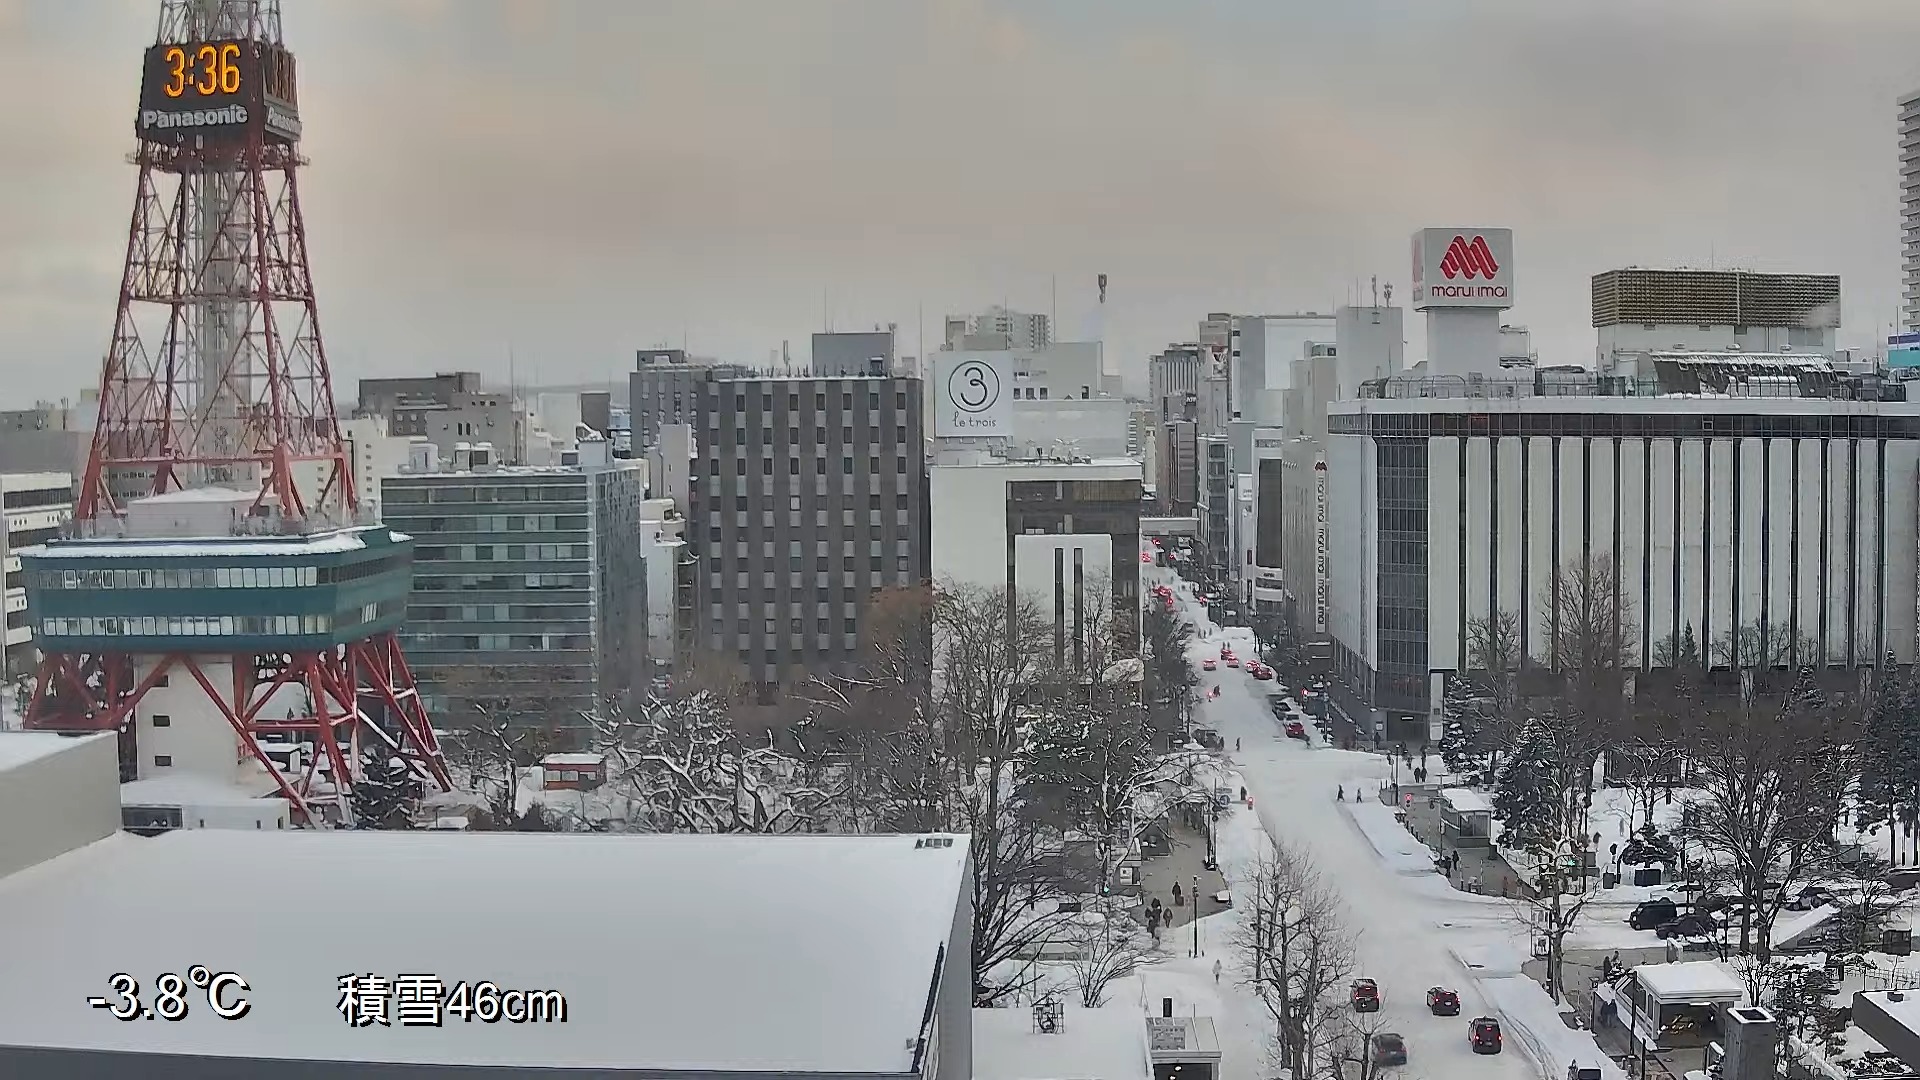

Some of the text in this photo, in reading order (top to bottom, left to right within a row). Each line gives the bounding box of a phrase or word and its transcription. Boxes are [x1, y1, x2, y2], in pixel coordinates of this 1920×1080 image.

[163, 43, 241, 97] 3:36
[143, 104, 248, 129] Panasonic
[1431, 285, 1475, 298] marui
[1477, 285, 1508, 298] imai
[952, 410, 997, 428] le trois
[1317, 528, 1325, 554] marui
[1317, 579, 1325, 605] marui
